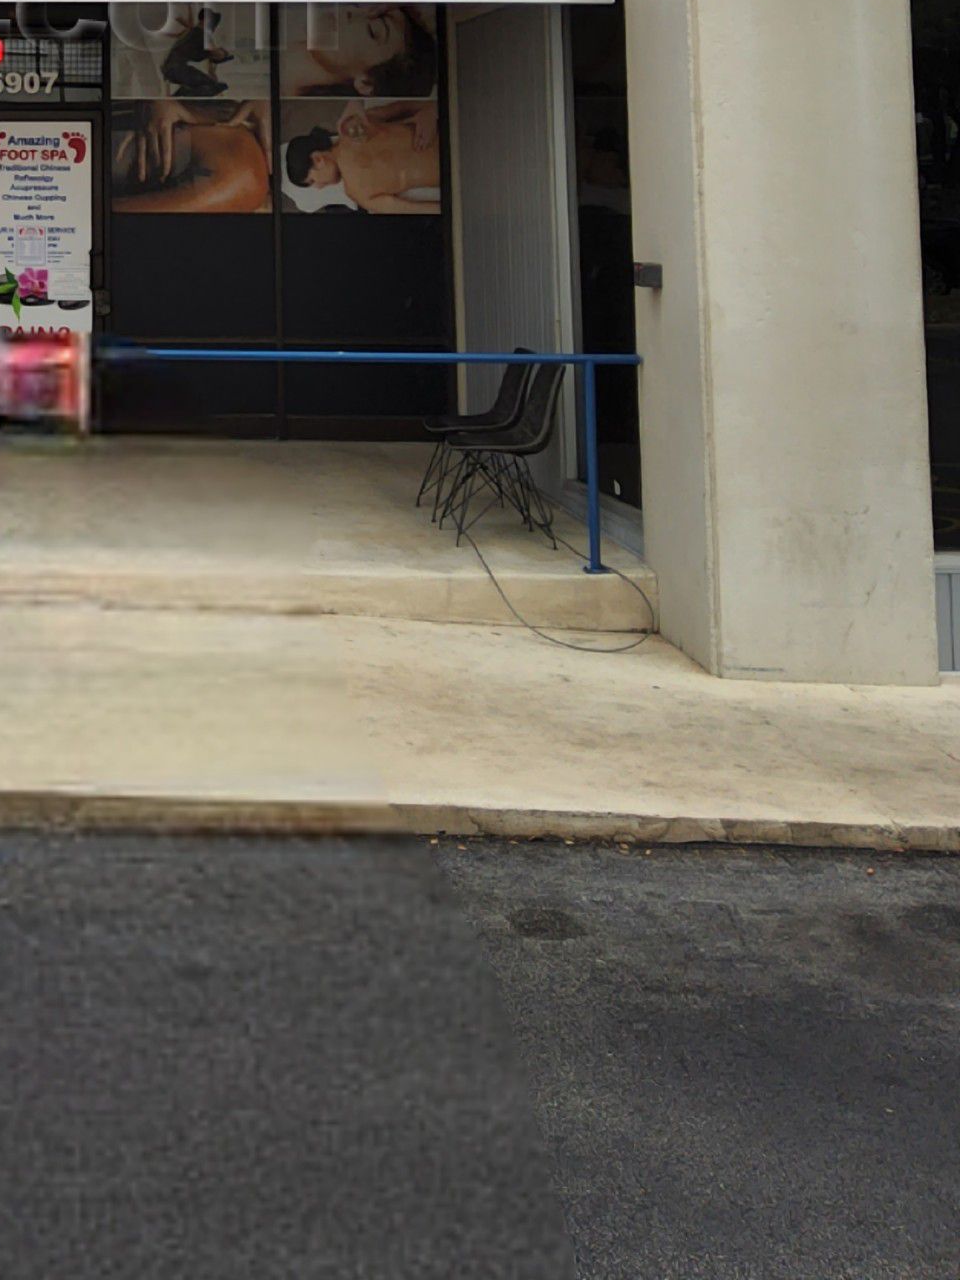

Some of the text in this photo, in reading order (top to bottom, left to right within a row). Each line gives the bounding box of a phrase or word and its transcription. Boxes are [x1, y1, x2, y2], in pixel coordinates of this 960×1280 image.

[8, 136, 61, 148] Amazing
[0, 149, 68, 161] FOOT SPA
